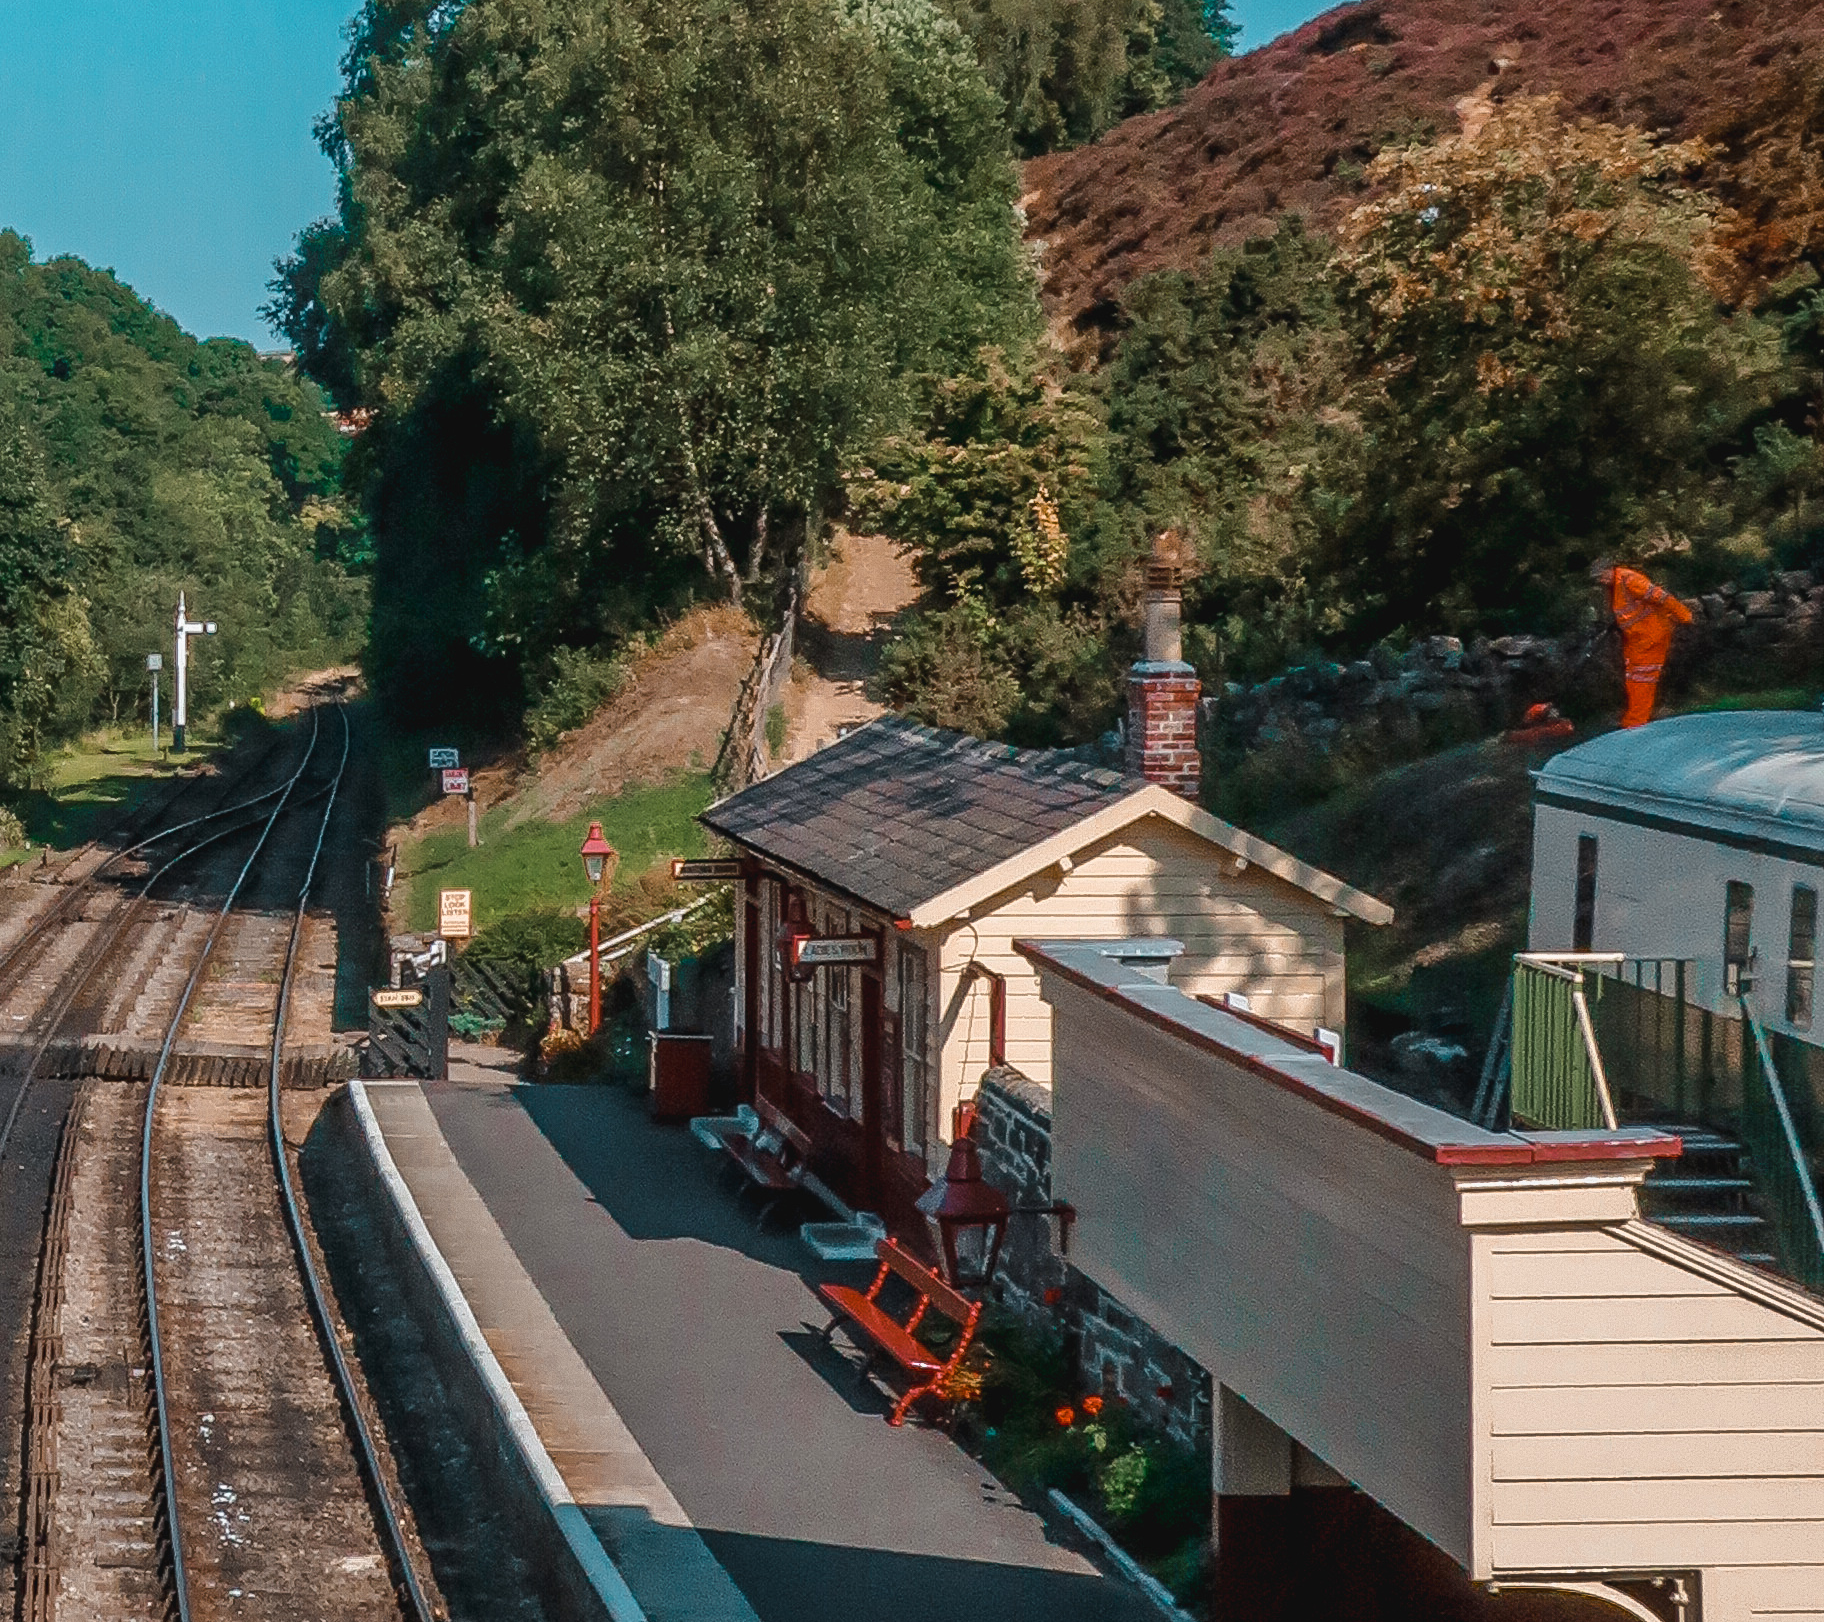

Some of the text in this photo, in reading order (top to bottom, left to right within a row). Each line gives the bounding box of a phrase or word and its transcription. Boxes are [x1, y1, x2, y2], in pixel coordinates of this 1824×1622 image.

[445, 893, 466, 901] STOP
[444, 901, 465, 909] LOOK
[441, 908, 469, 916] LISTEN
